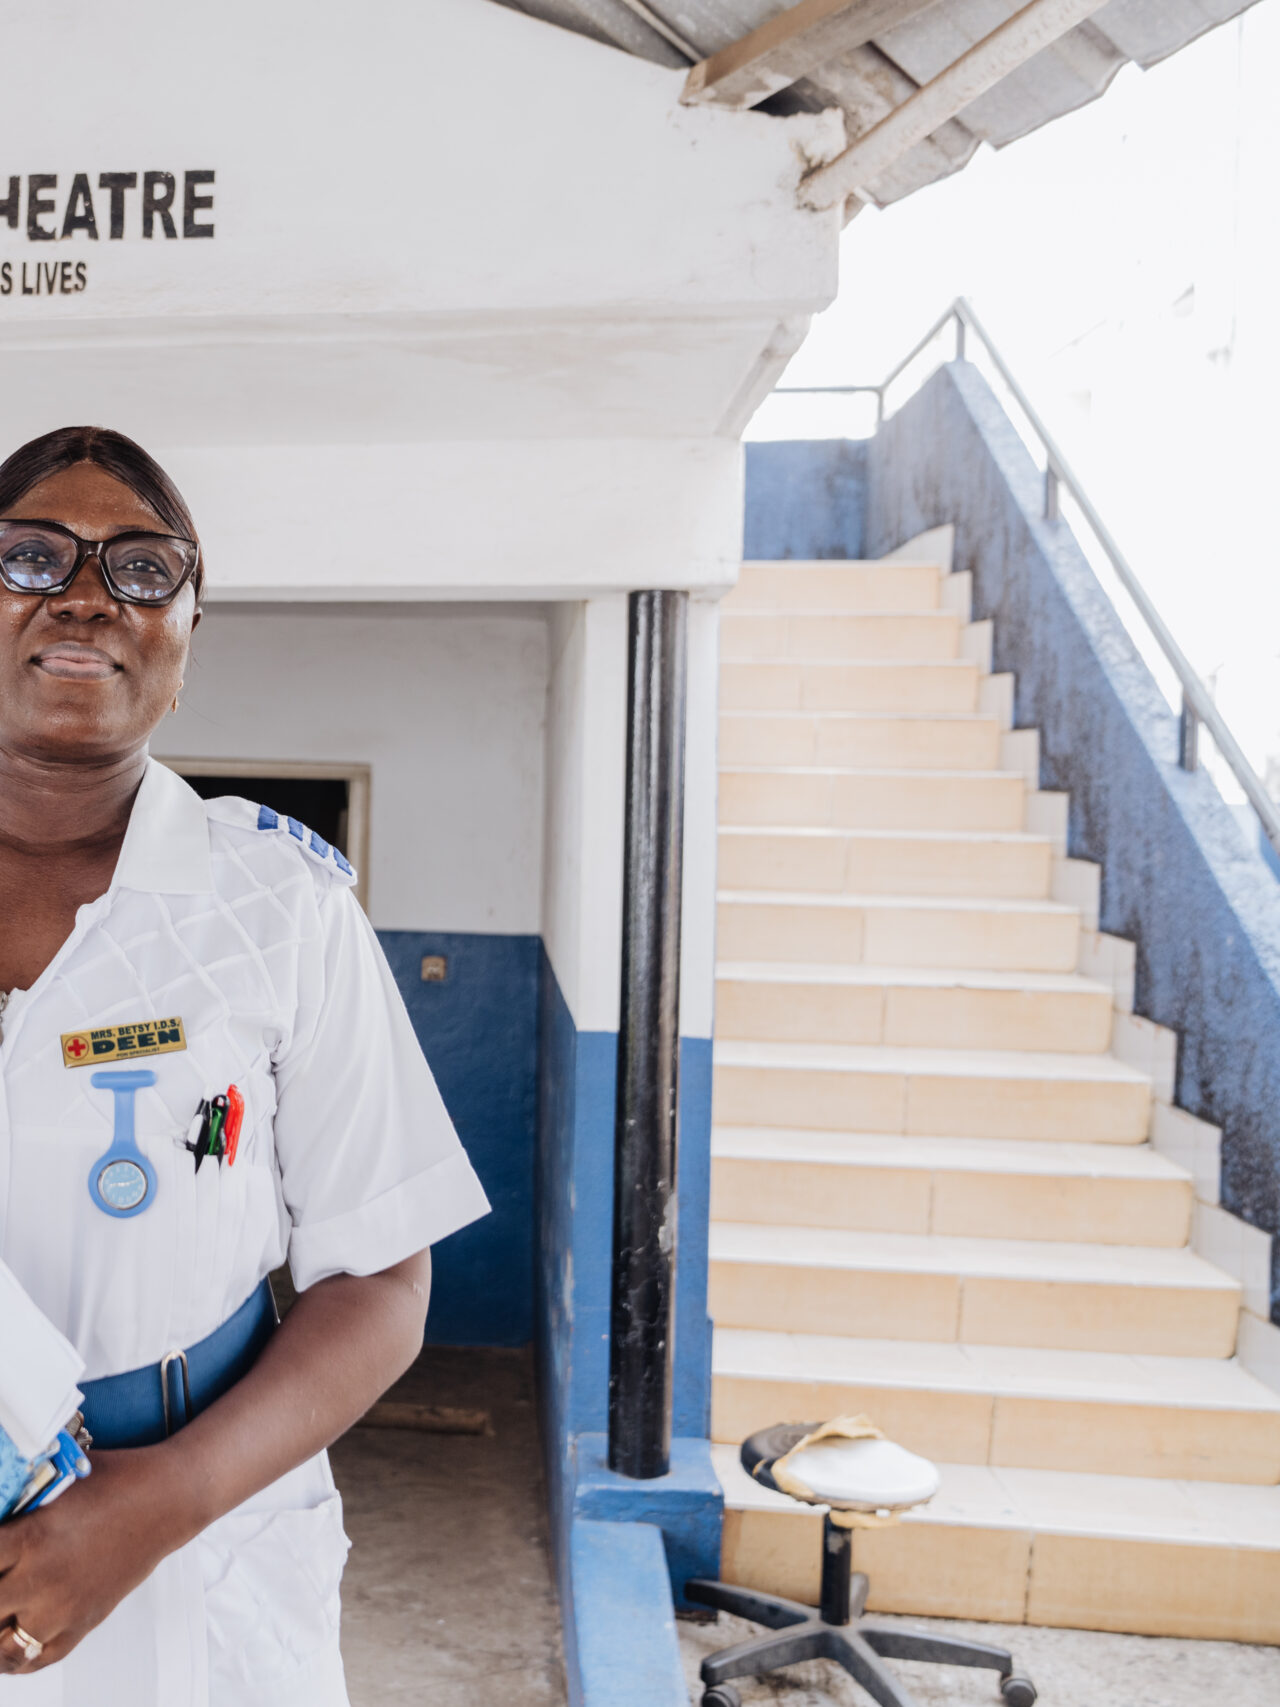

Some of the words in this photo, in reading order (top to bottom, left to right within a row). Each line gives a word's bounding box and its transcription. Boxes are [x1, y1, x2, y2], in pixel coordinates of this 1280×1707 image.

[21, 260, 87, 296] LIVES
[90, 1029, 115, 1040] MRS.
[118, 1022, 151, 1036] BETSY
[154, 1018, 180, 1030] I.D.S.
[92, 1028, 181, 1055] DEEN
